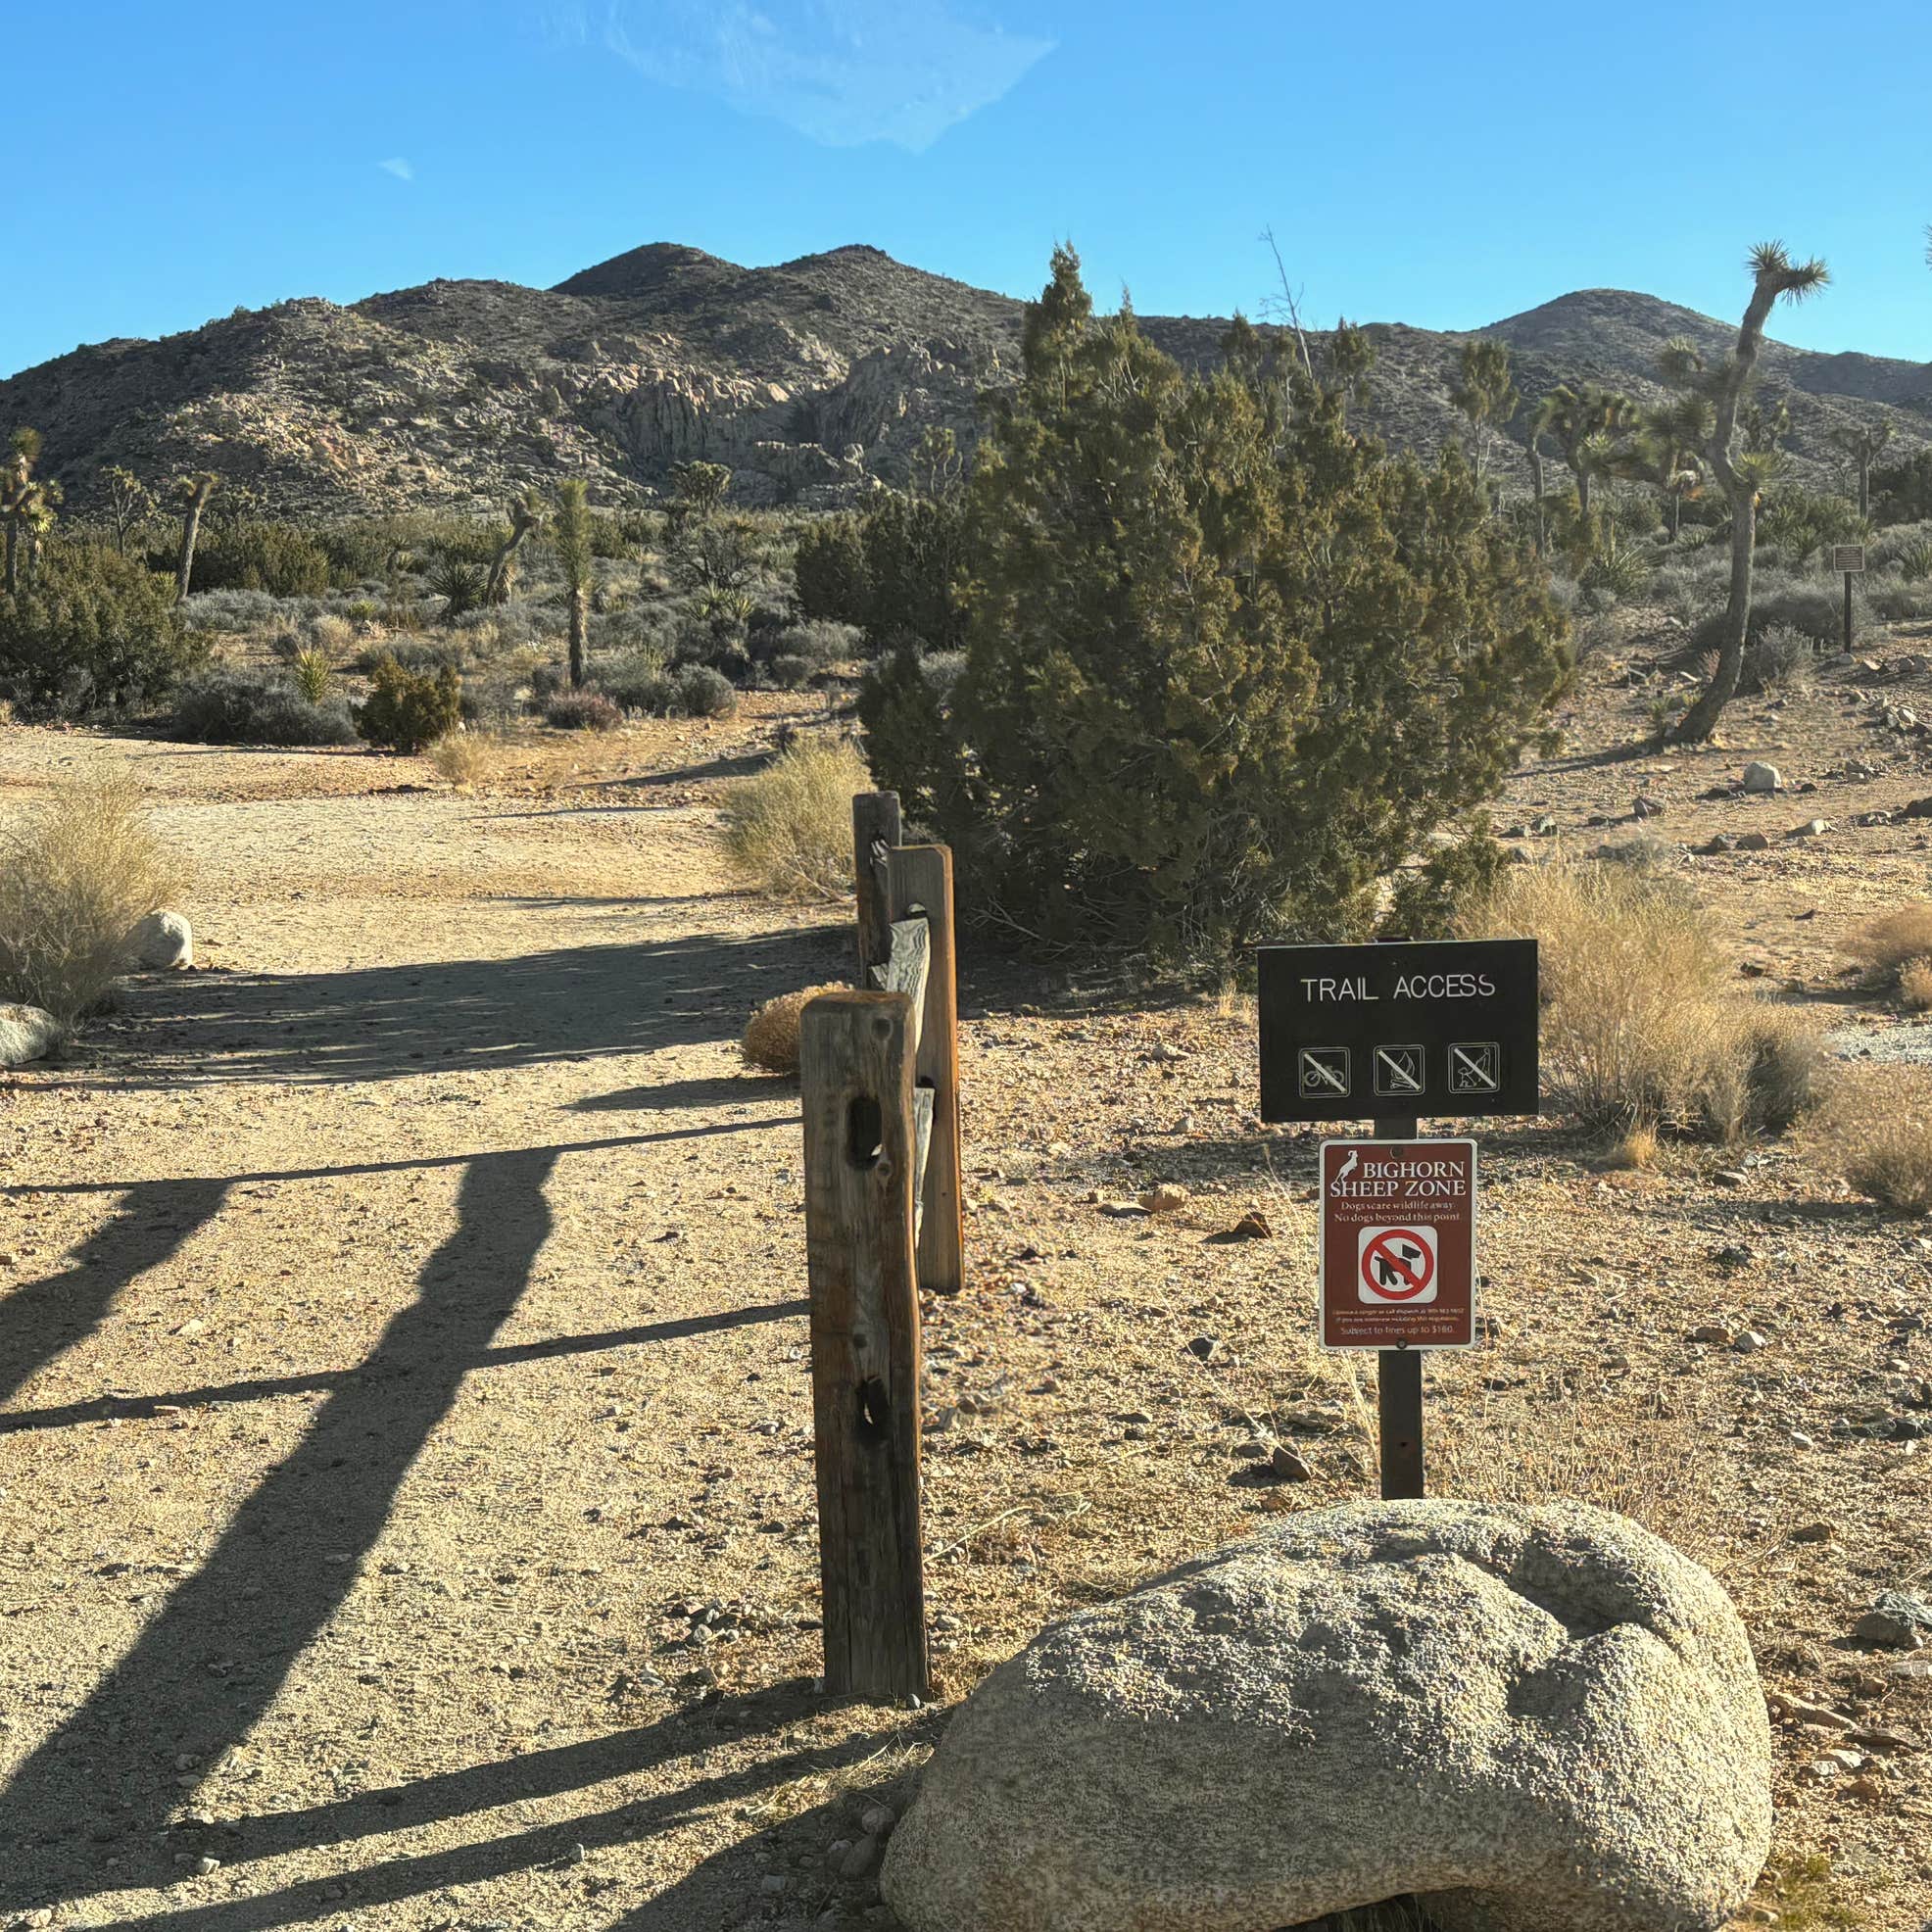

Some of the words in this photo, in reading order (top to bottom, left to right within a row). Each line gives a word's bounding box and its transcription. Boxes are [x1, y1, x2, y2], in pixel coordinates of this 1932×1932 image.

[1301, 977, 1379, 1002] TRAIL
[1393, 974, 1495, 999] ACCESS
[1363, 1161, 1465, 1179] BIGHORN
[1330, 1181, 1399, 1197] SHEEP
[1405, 1180, 1467, 1196] ZONE
[1341, 1201, 1365, 1212] Dogs
[1392, 1200, 1428, 1210] wildlife
[1351, 1213, 1373, 1224] dogs
[1376, 1213, 1411, 1223] beyond
